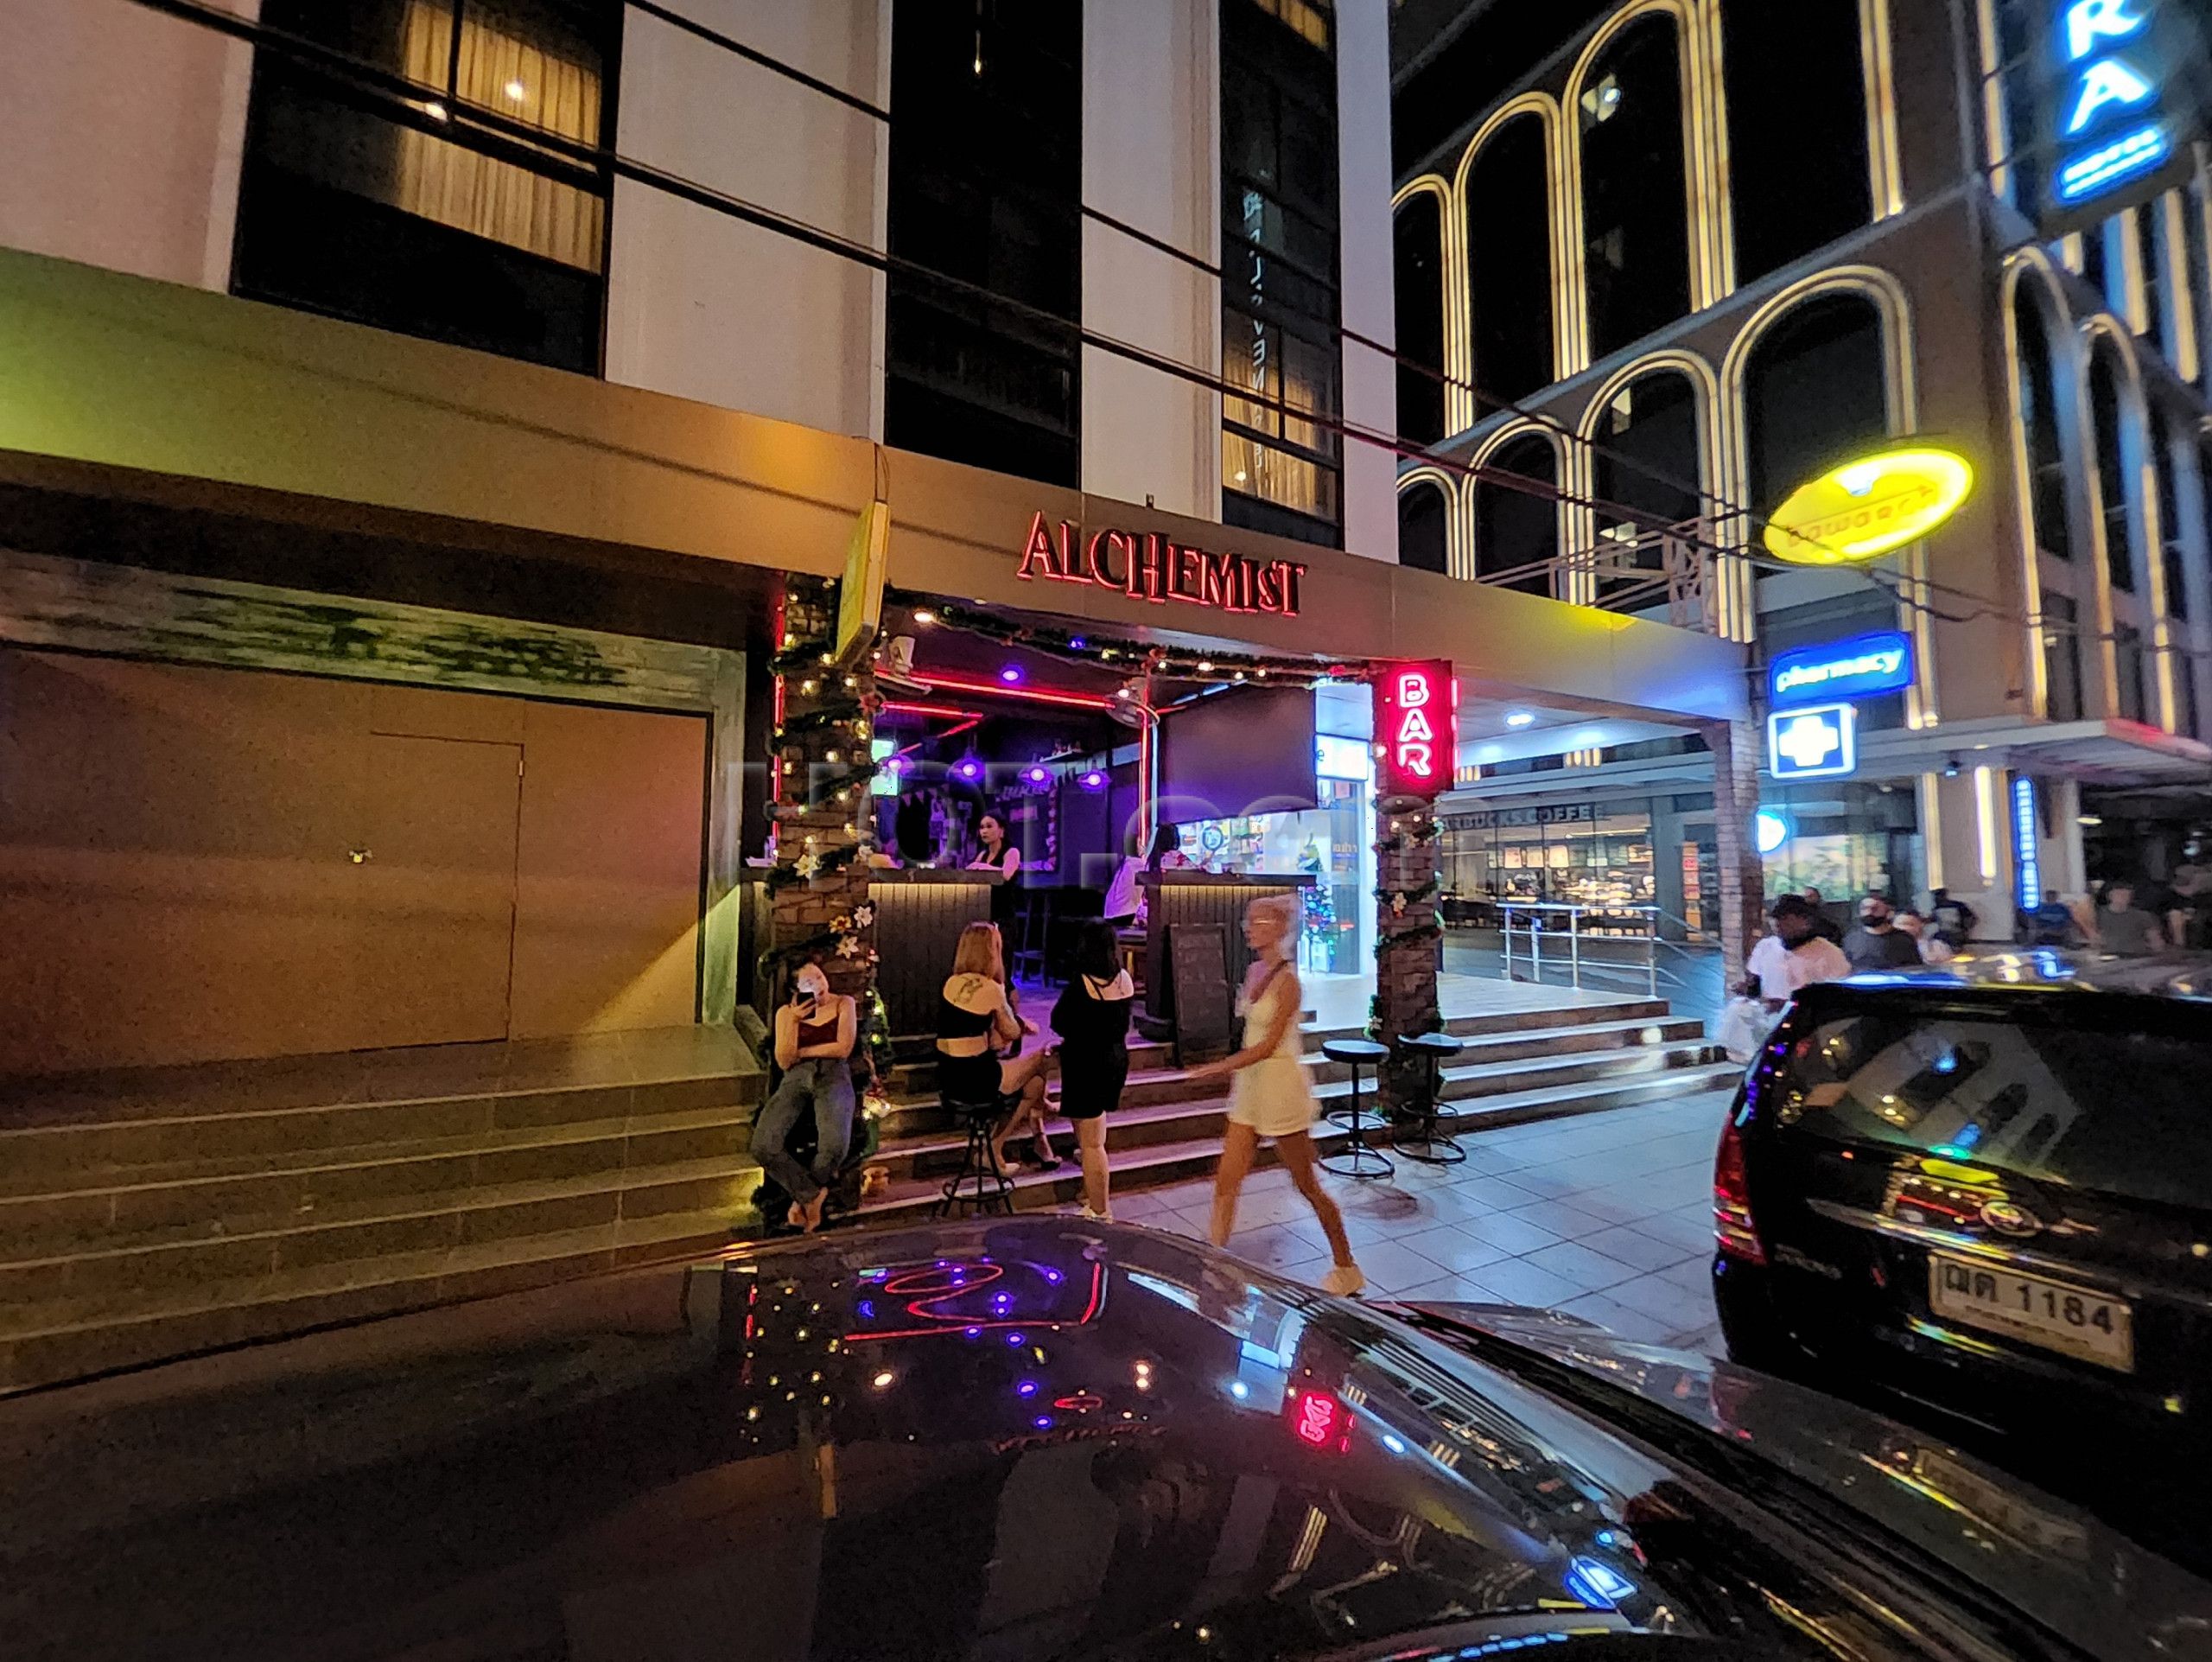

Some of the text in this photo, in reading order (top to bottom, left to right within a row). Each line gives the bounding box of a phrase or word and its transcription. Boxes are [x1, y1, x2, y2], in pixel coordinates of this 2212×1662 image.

[1016, 509, 1308, 617] ALCHEMIST
[1395, 672, 1435, 778] BAR
[1526, 804, 1605, 825] COFFEE
[2017, 1283, 2114, 1335] 1184
